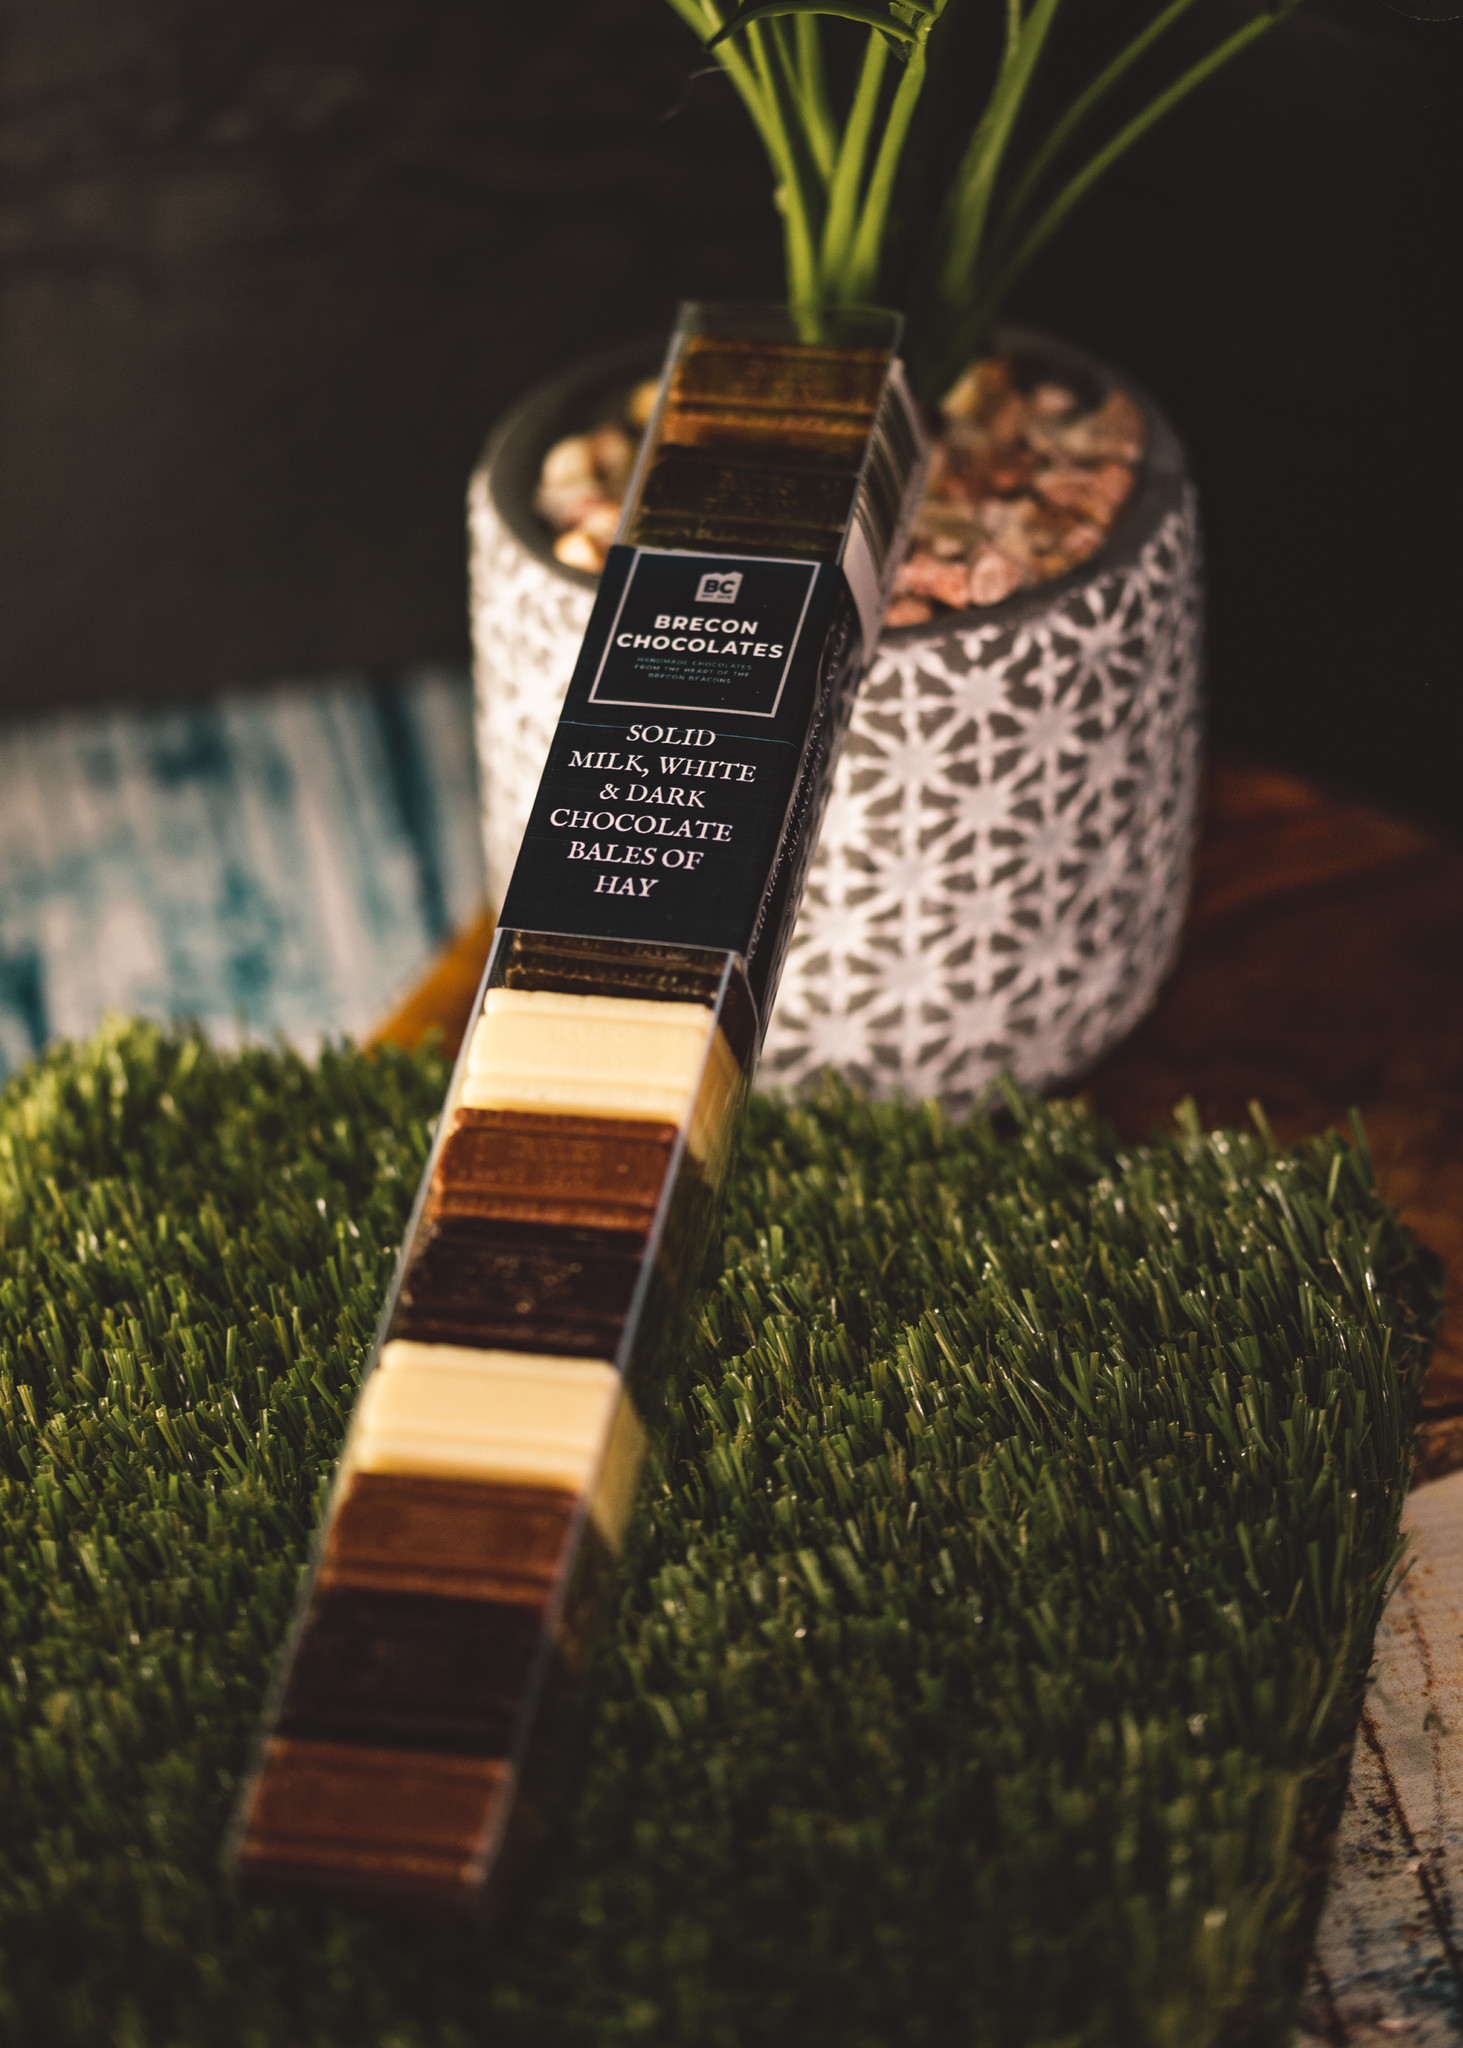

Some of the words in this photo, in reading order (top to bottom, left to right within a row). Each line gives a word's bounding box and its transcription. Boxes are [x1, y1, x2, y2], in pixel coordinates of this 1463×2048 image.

[704, 579, 735, 594] BC
[654, 614, 758, 635] BRECON
[616, 633, 784, 659] CHOCOLATES
[647, 672, 686, 682] BRECON
[691, 660, 752, 671] CHOCOLATES
[626, 724, 716, 747] SOLID
[568, 751, 650, 778] MILK,
[659, 756, 757, 783] WHITE
[599, 783, 620, 800] &
[625, 784, 706, 808] DARK
[550, 808, 734, 842] CHOCOLATE
[567, 841, 658, 866] BALES
[661, 849, 704, 870] OF
[594, 875, 659, 898] HAY
